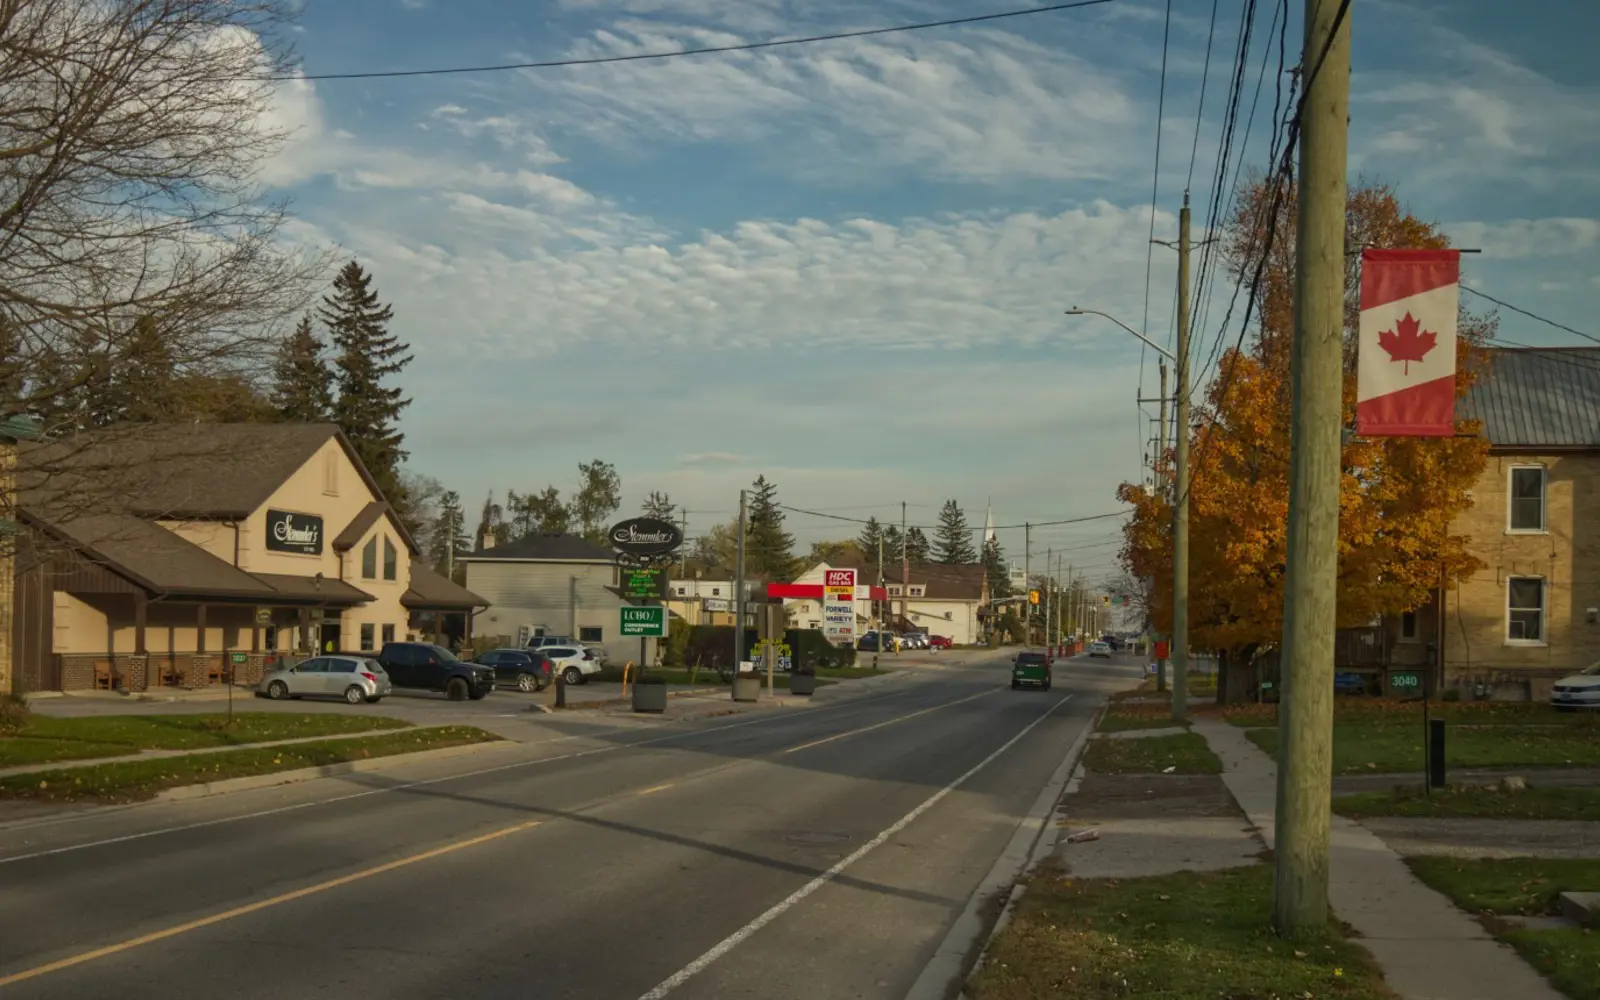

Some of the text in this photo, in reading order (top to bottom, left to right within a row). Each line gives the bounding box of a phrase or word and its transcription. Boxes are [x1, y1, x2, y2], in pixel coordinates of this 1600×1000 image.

[613, 524, 675, 544] Stemmler's
[829, 571, 852, 581] HDC
[826, 605, 852, 613] FORWELL
[1391, 676, 1418, 686] 3040
